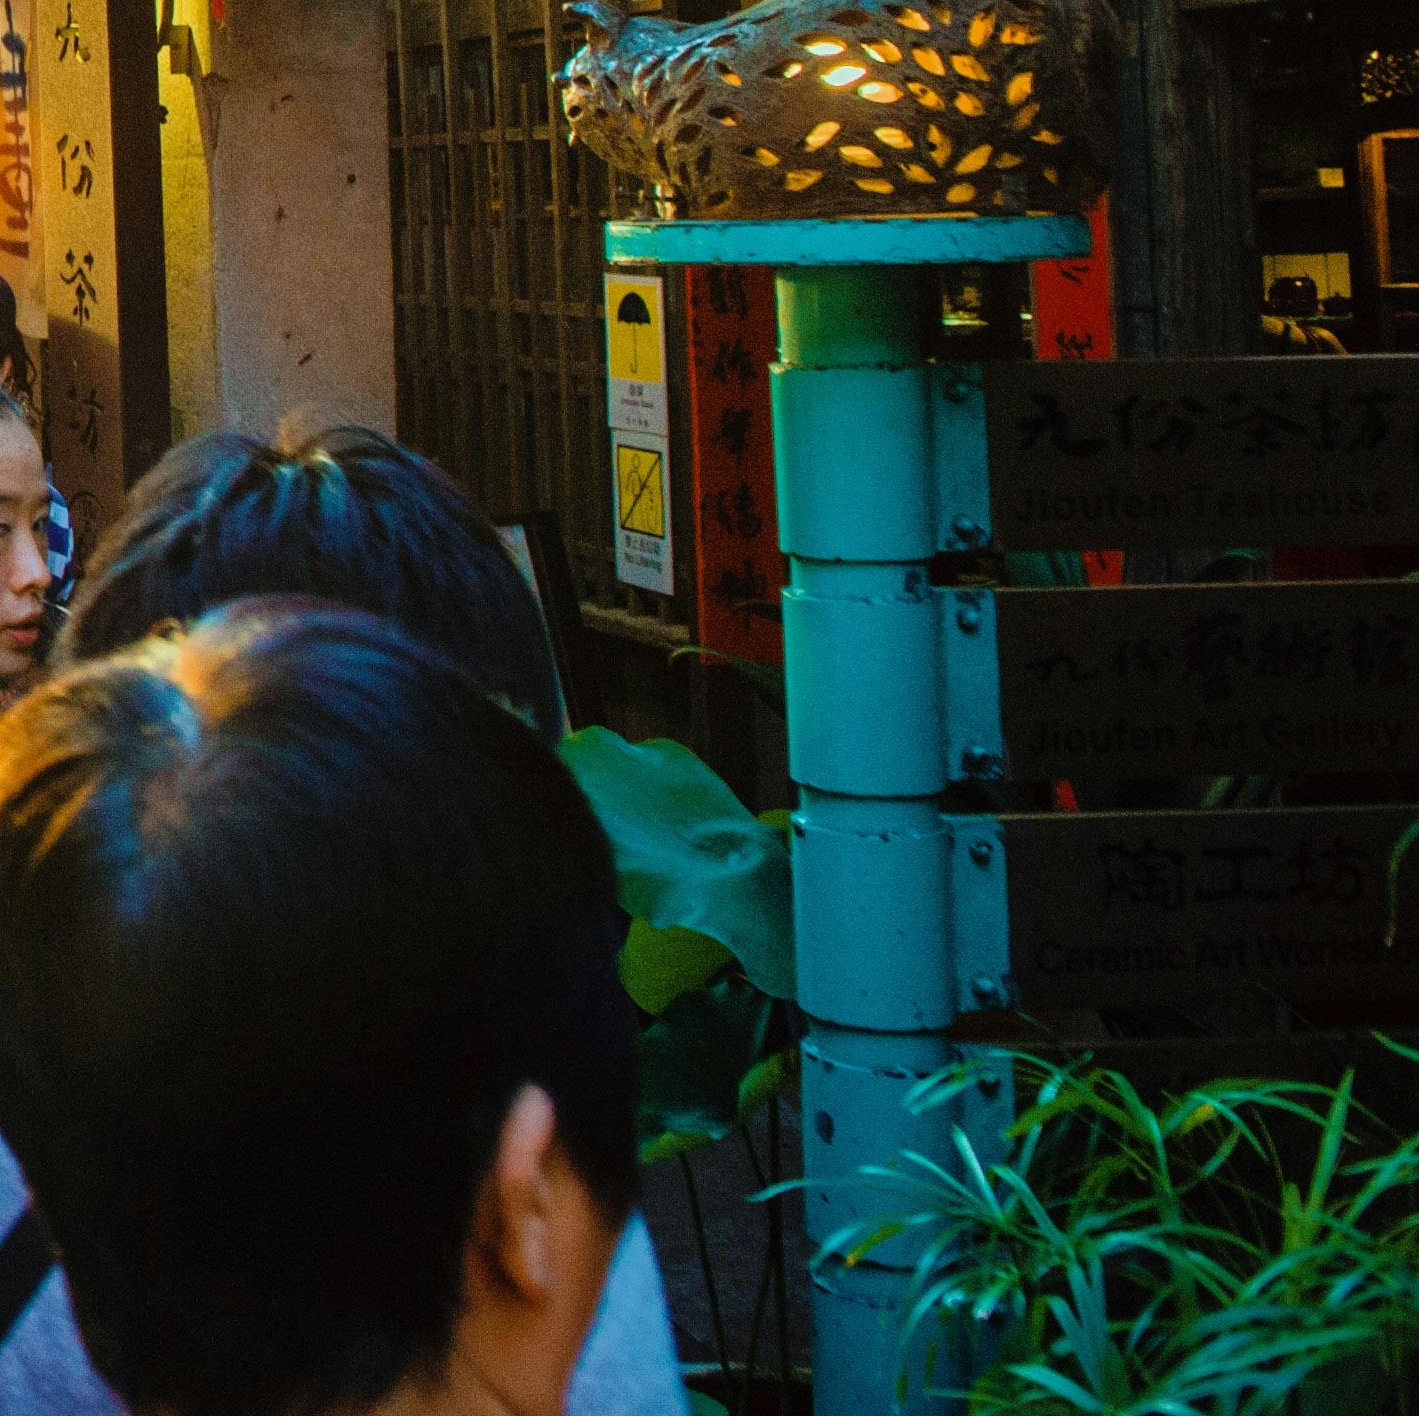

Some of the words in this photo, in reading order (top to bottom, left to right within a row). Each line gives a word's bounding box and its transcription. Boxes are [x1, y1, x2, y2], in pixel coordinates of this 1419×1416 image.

[1186, 485, 1392, 519] Teahouse
[1191, 718, 1247, 751] Art
[1263, 713, 1402, 752] Gallery
[1095, 836, 1370, 911] 陶工坊
[1036, 938, 1186, 975] Ceramic
[1195, 935, 1247, 969] Art
